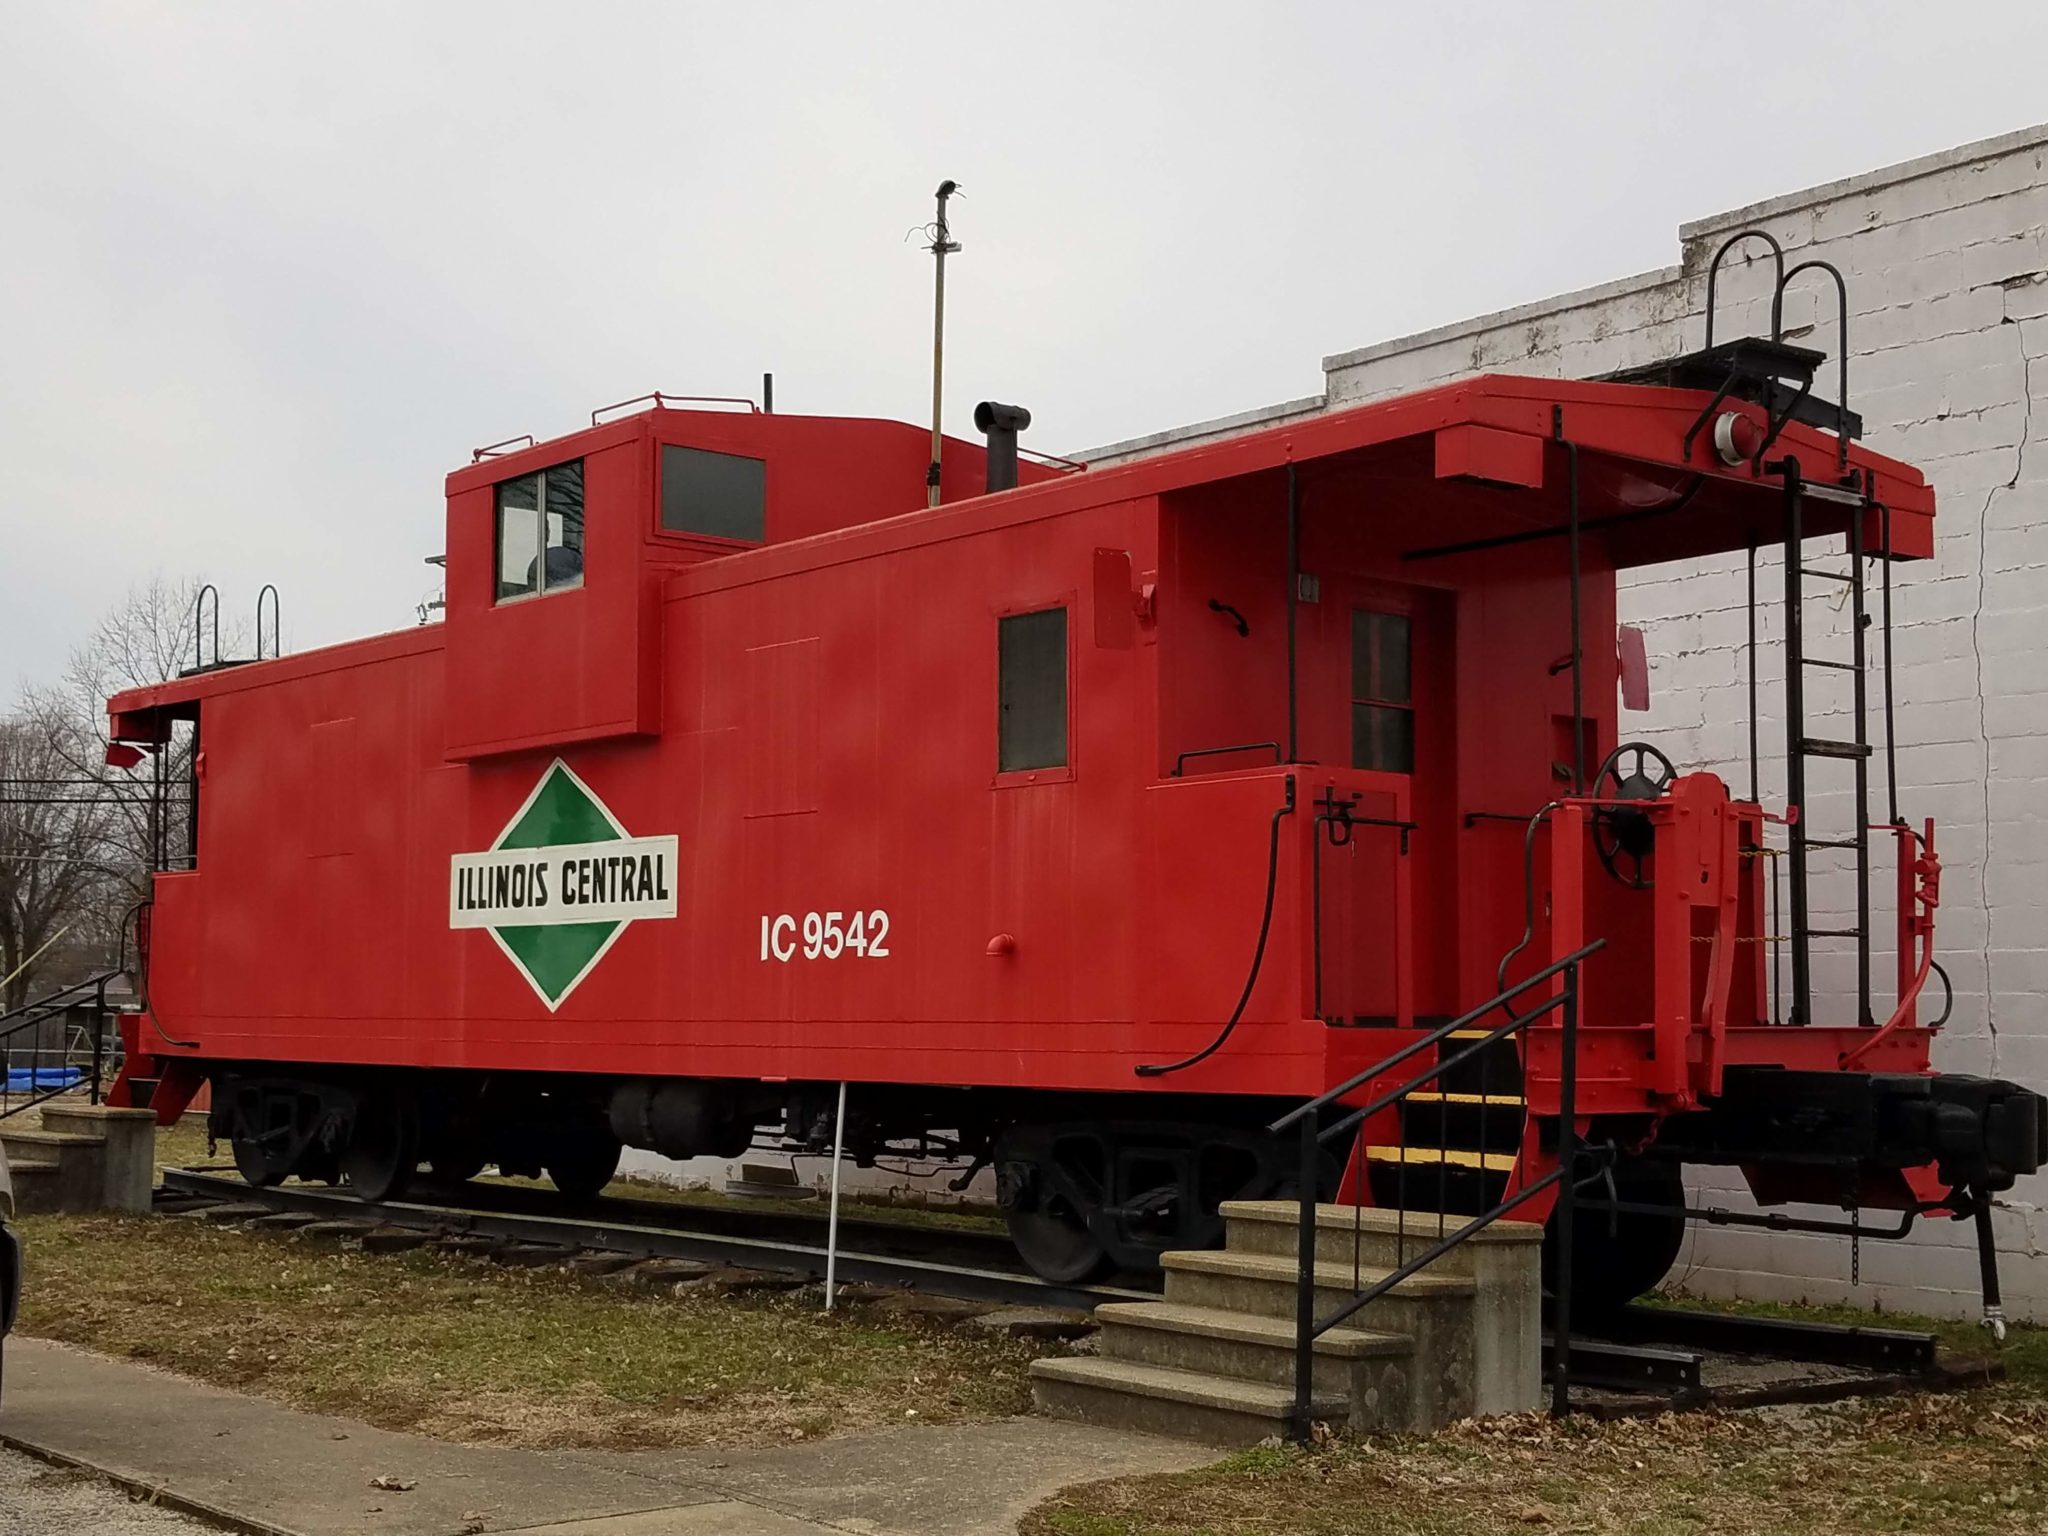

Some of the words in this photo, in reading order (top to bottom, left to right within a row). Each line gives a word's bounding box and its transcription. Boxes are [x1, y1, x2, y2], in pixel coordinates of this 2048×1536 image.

[458, 861, 548, 910] ILLINOIS
[561, 854, 669, 905] CENTRAL
[760, 914, 796, 962] IC
[803, 909, 890, 959] 9542
